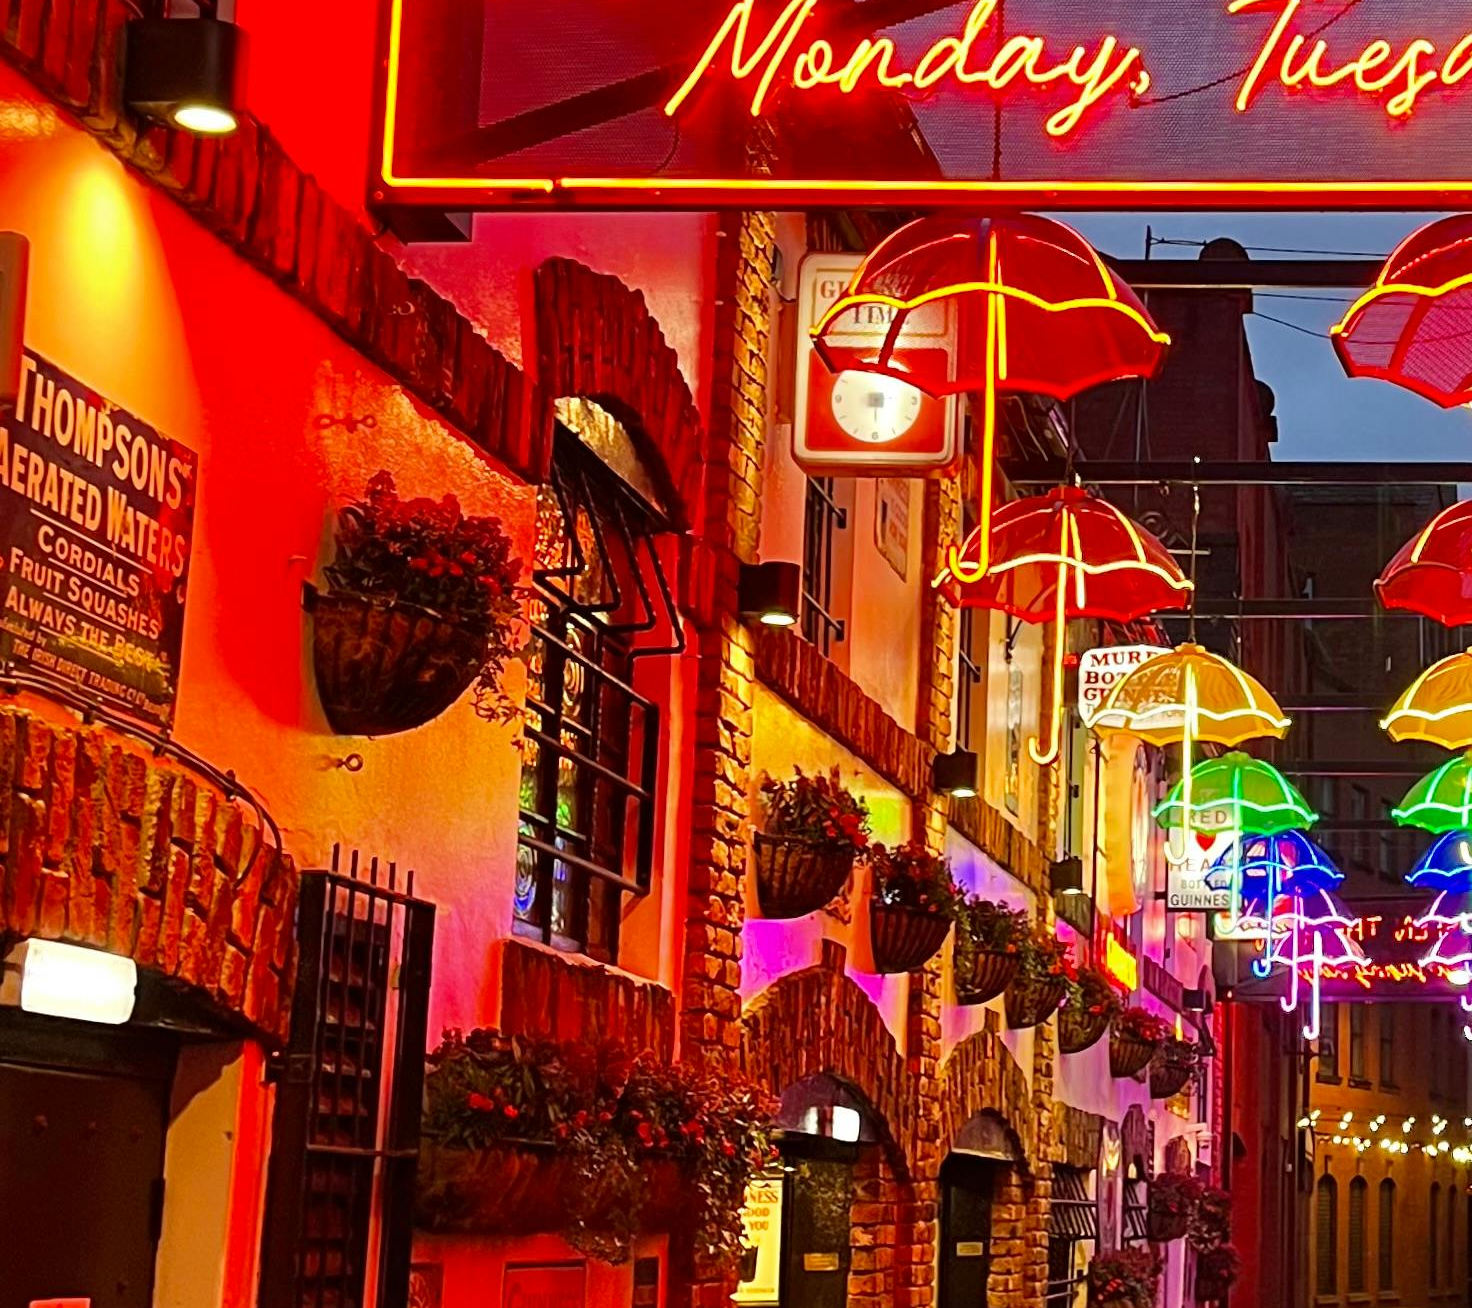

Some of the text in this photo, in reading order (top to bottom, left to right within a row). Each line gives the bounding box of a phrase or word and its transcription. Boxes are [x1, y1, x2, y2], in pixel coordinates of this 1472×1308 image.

[38, 524, 140, 597] CORDIALS
[107, 485, 185, 578] WATERS
[5, 586, 77, 636] ALWAYS
[81, 622, 110, 648] THE
[9, 547, 65, 594] FRUIT
[67, 576, 160, 640] SQUASHES
